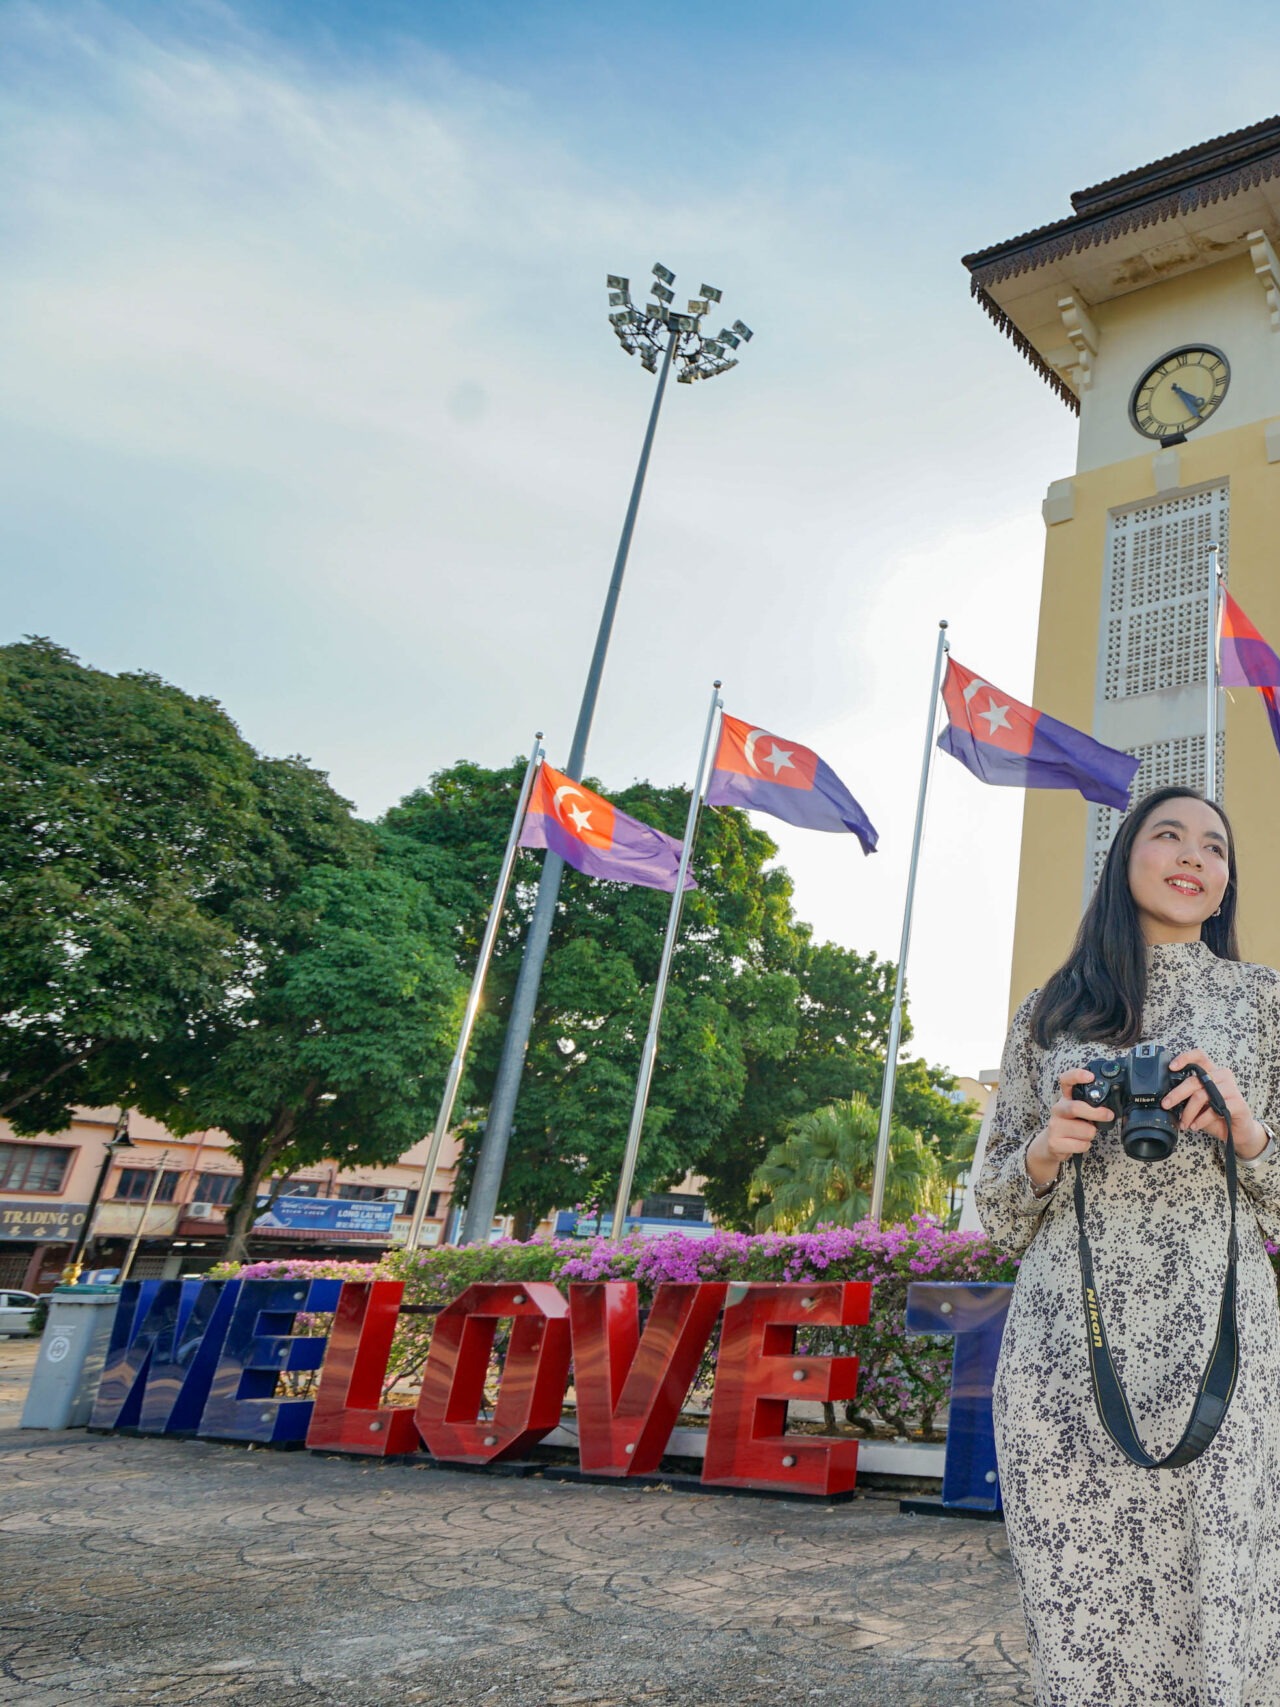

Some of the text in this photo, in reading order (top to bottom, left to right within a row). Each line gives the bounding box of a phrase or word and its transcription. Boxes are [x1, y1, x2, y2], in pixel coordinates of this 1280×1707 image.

[1134, 1096, 1156, 1104] Nikon
[3, 1210, 70, 1225] TRADING
[1086, 1287, 1103, 1348] Nikon
[88, 1279, 344, 1443] WE
[305, 1280, 870, 1496] LOVE
